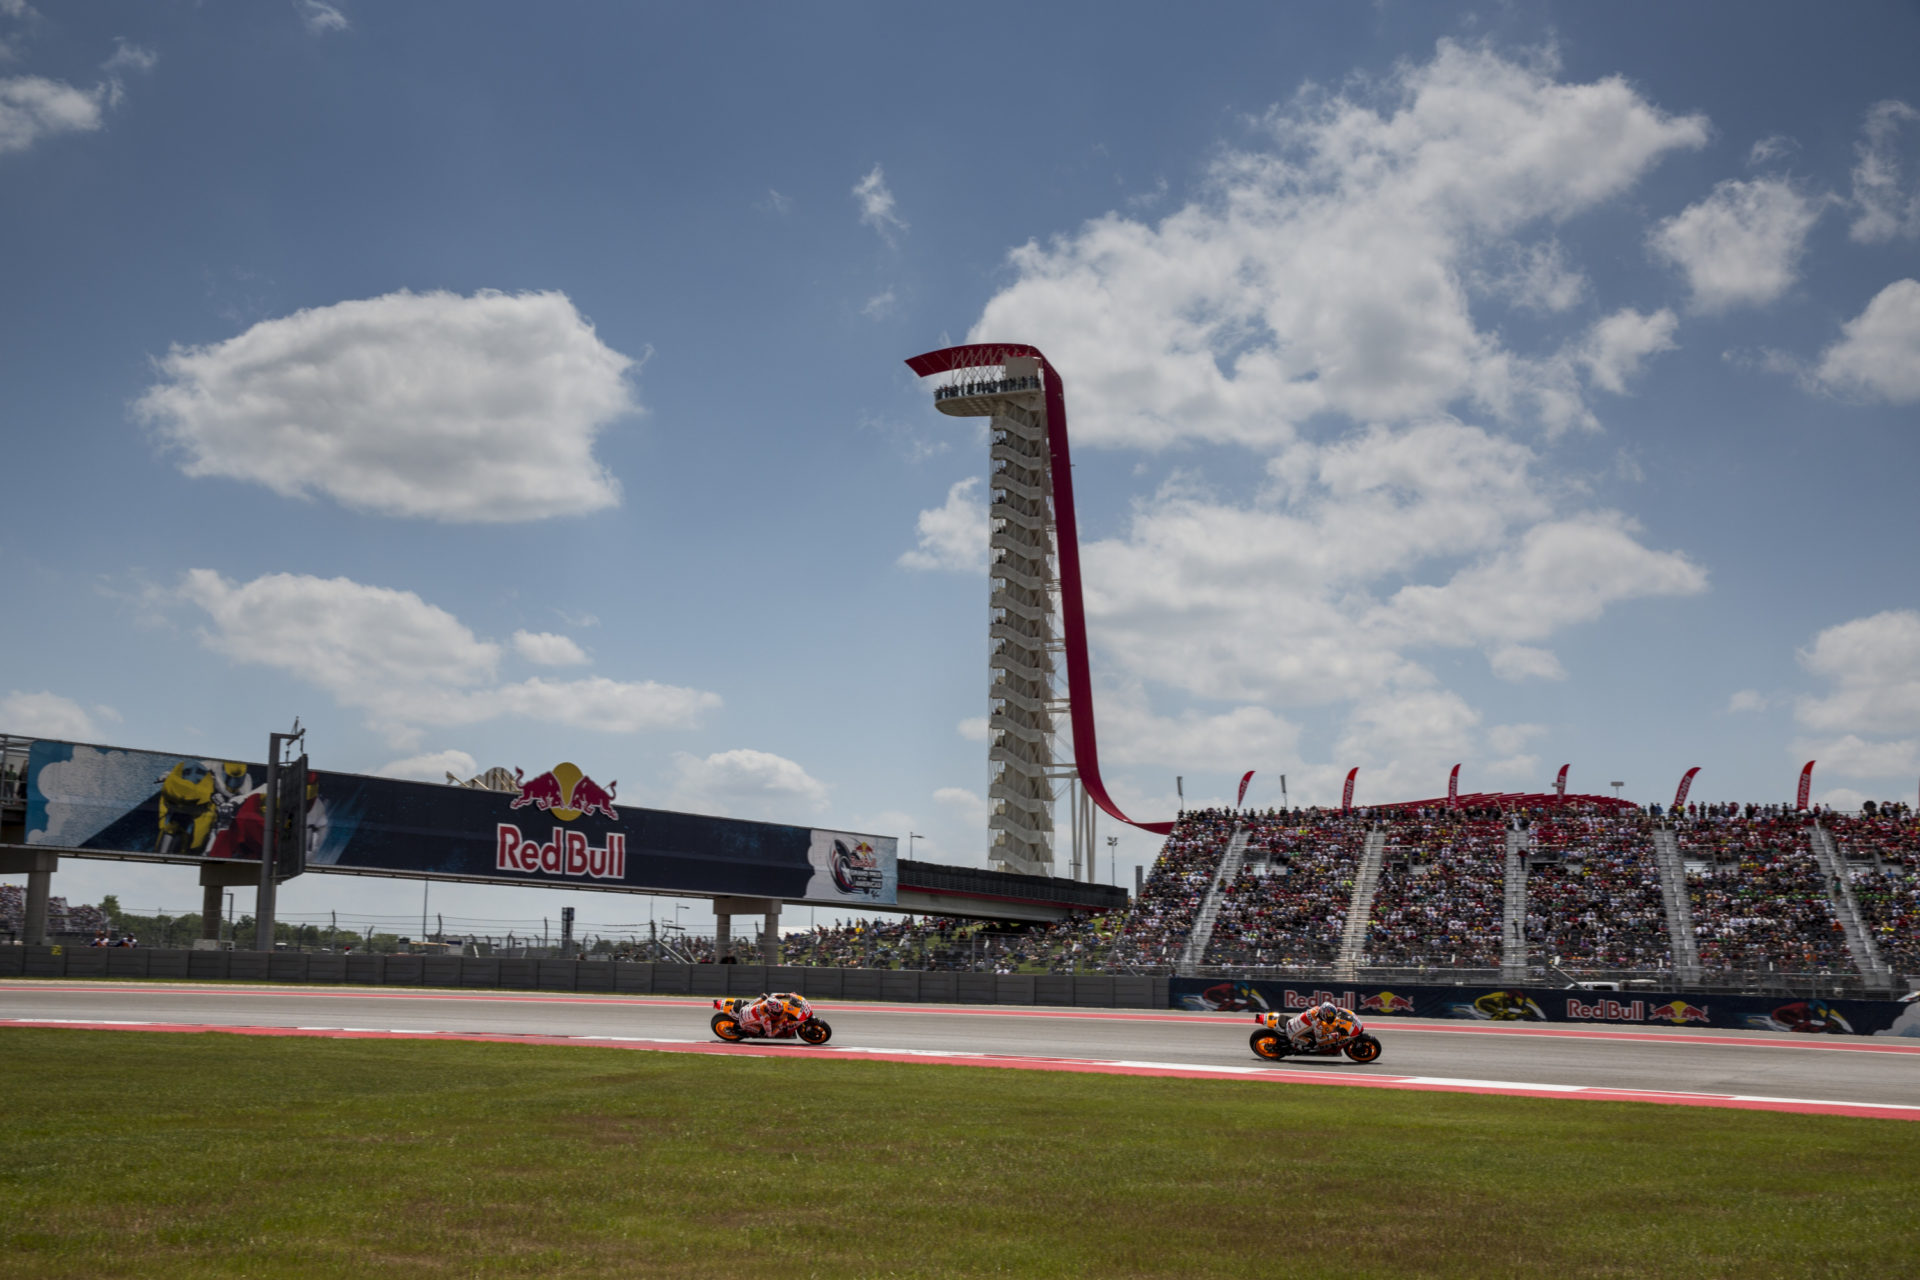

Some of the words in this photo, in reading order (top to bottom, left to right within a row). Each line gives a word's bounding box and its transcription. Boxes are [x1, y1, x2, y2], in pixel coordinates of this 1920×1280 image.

[1800, 773, 1810, 807] DUCATI
[497, 823, 563, 874] Red
[566, 830, 625, 879] Bull
[1285, 990, 1319, 1008] Red
[1321, 992, 1355, 1010] Bull
[1567, 998, 1605, 1018] Red
[1607, 1000, 1644, 1021] Bull
